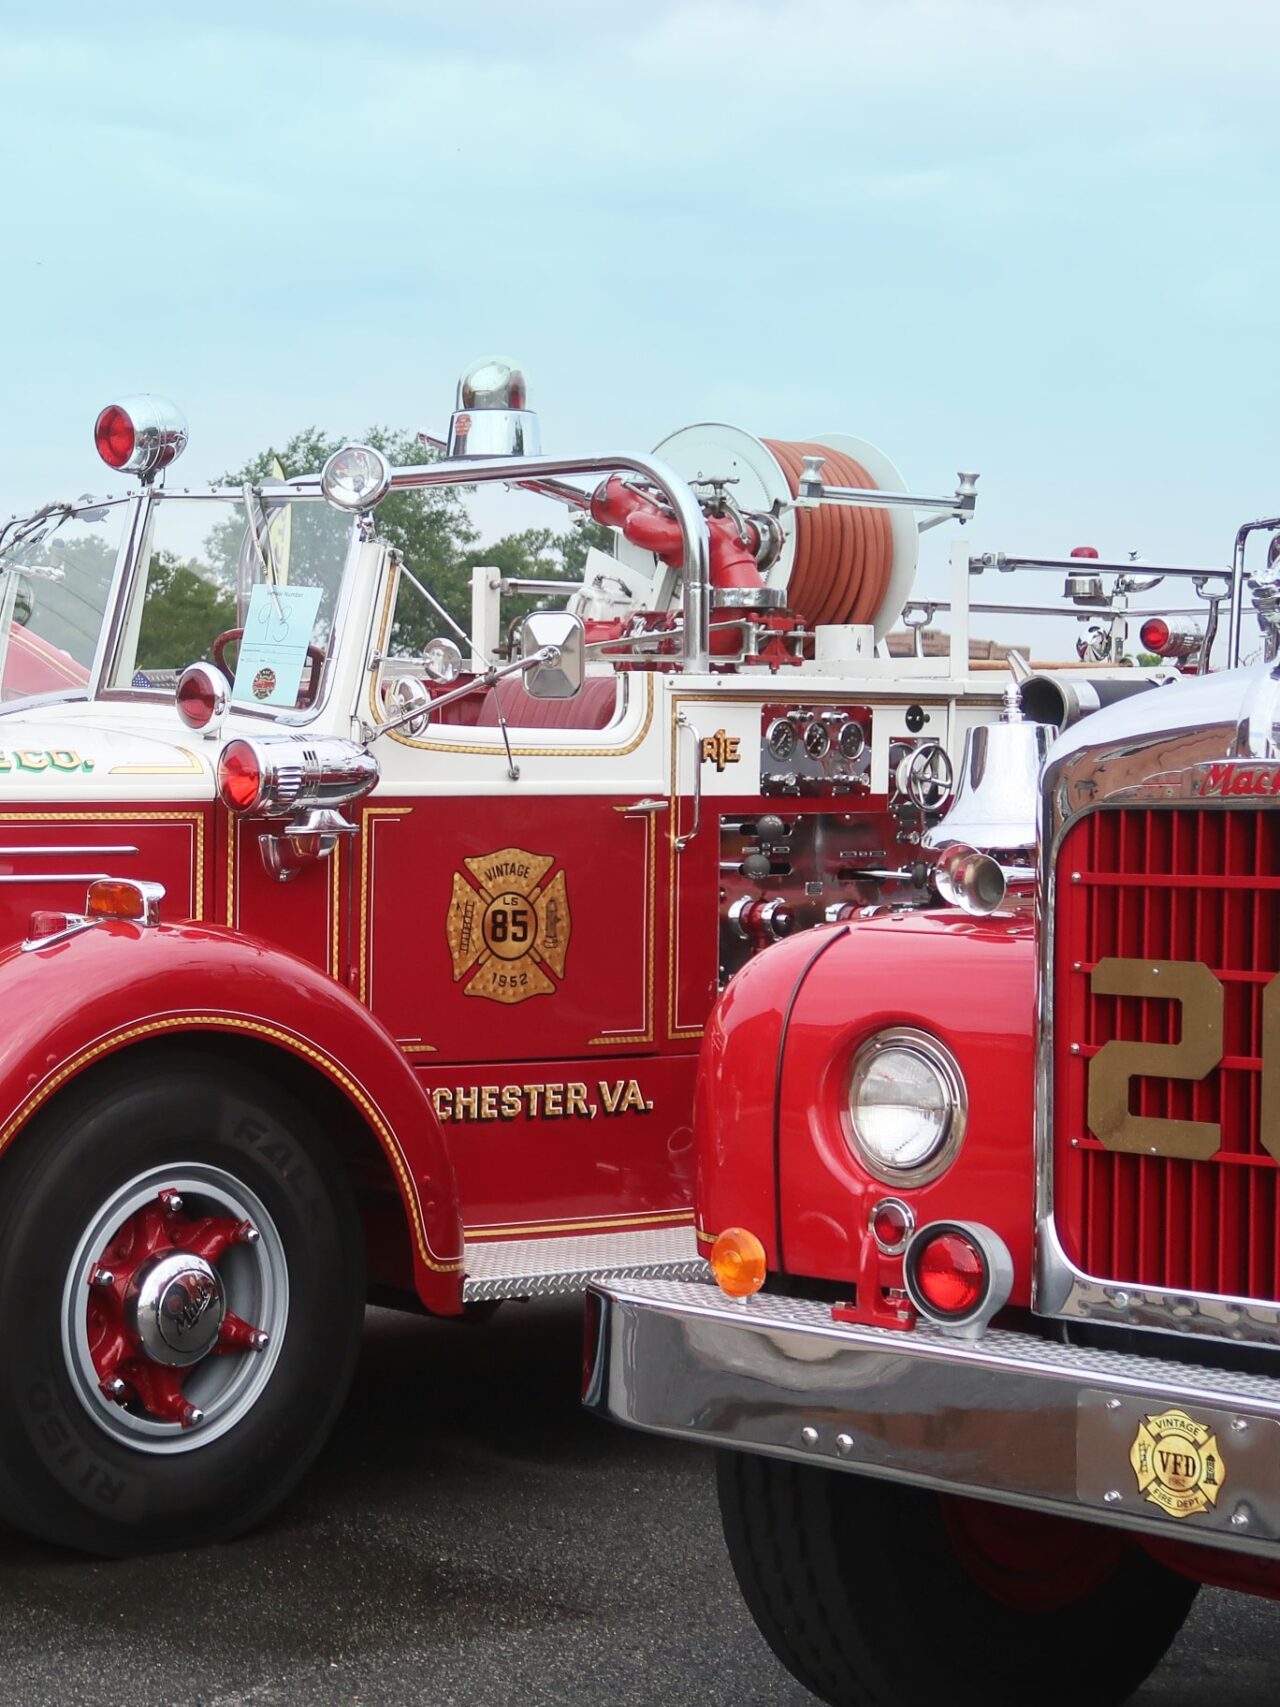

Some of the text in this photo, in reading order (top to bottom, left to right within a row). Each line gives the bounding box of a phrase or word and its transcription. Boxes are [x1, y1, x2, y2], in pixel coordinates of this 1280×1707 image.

[13, 751, 95, 774] CO.
[484, 862, 531, 882] VINTAGE
[491, 909, 528, 942] 85
[492, 972, 528, 988] 1952
[1087, 957, 1280, 1167] 2
[426, 1079, 654, 1121] CHESTER, VA.
[1155, 1418, 1201, 1437] VINTAGE
[1158, 1450, 1197, 1478] VFD
[1153, 1488, 1173, 1506] FIRE
